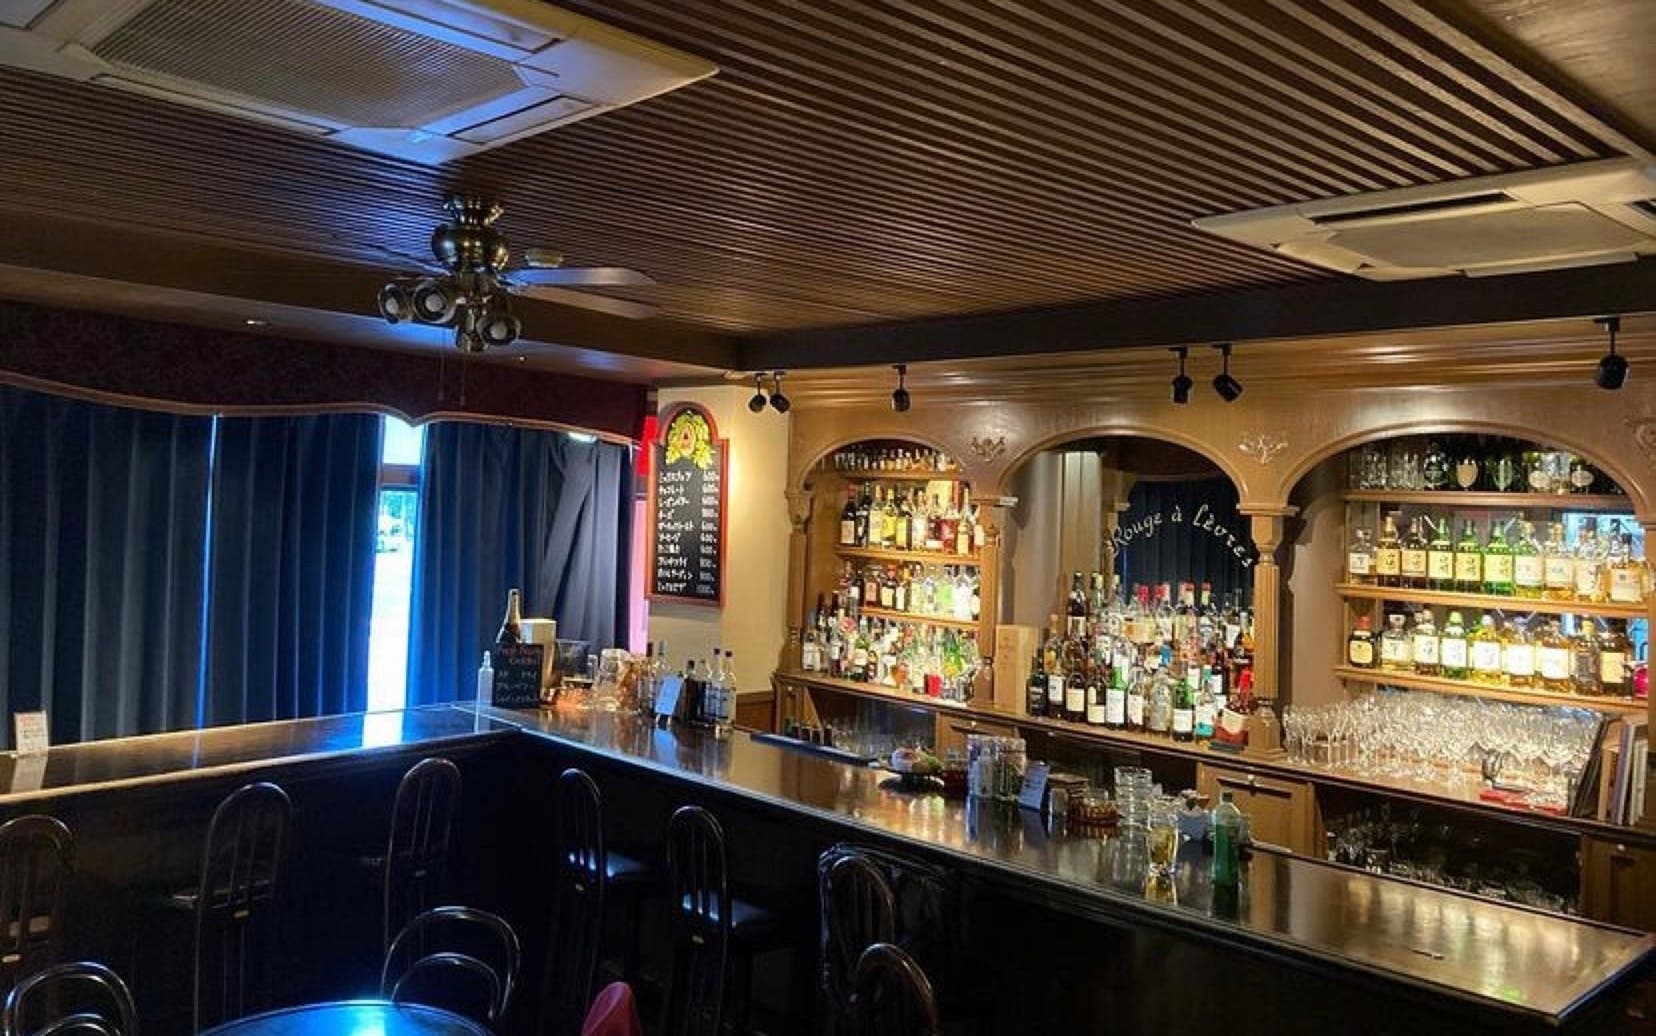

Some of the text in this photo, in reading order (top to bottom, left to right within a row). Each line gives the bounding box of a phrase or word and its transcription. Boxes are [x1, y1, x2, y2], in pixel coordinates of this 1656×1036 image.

[1112, 504, 1253, 568] Rouge à Lèvres
